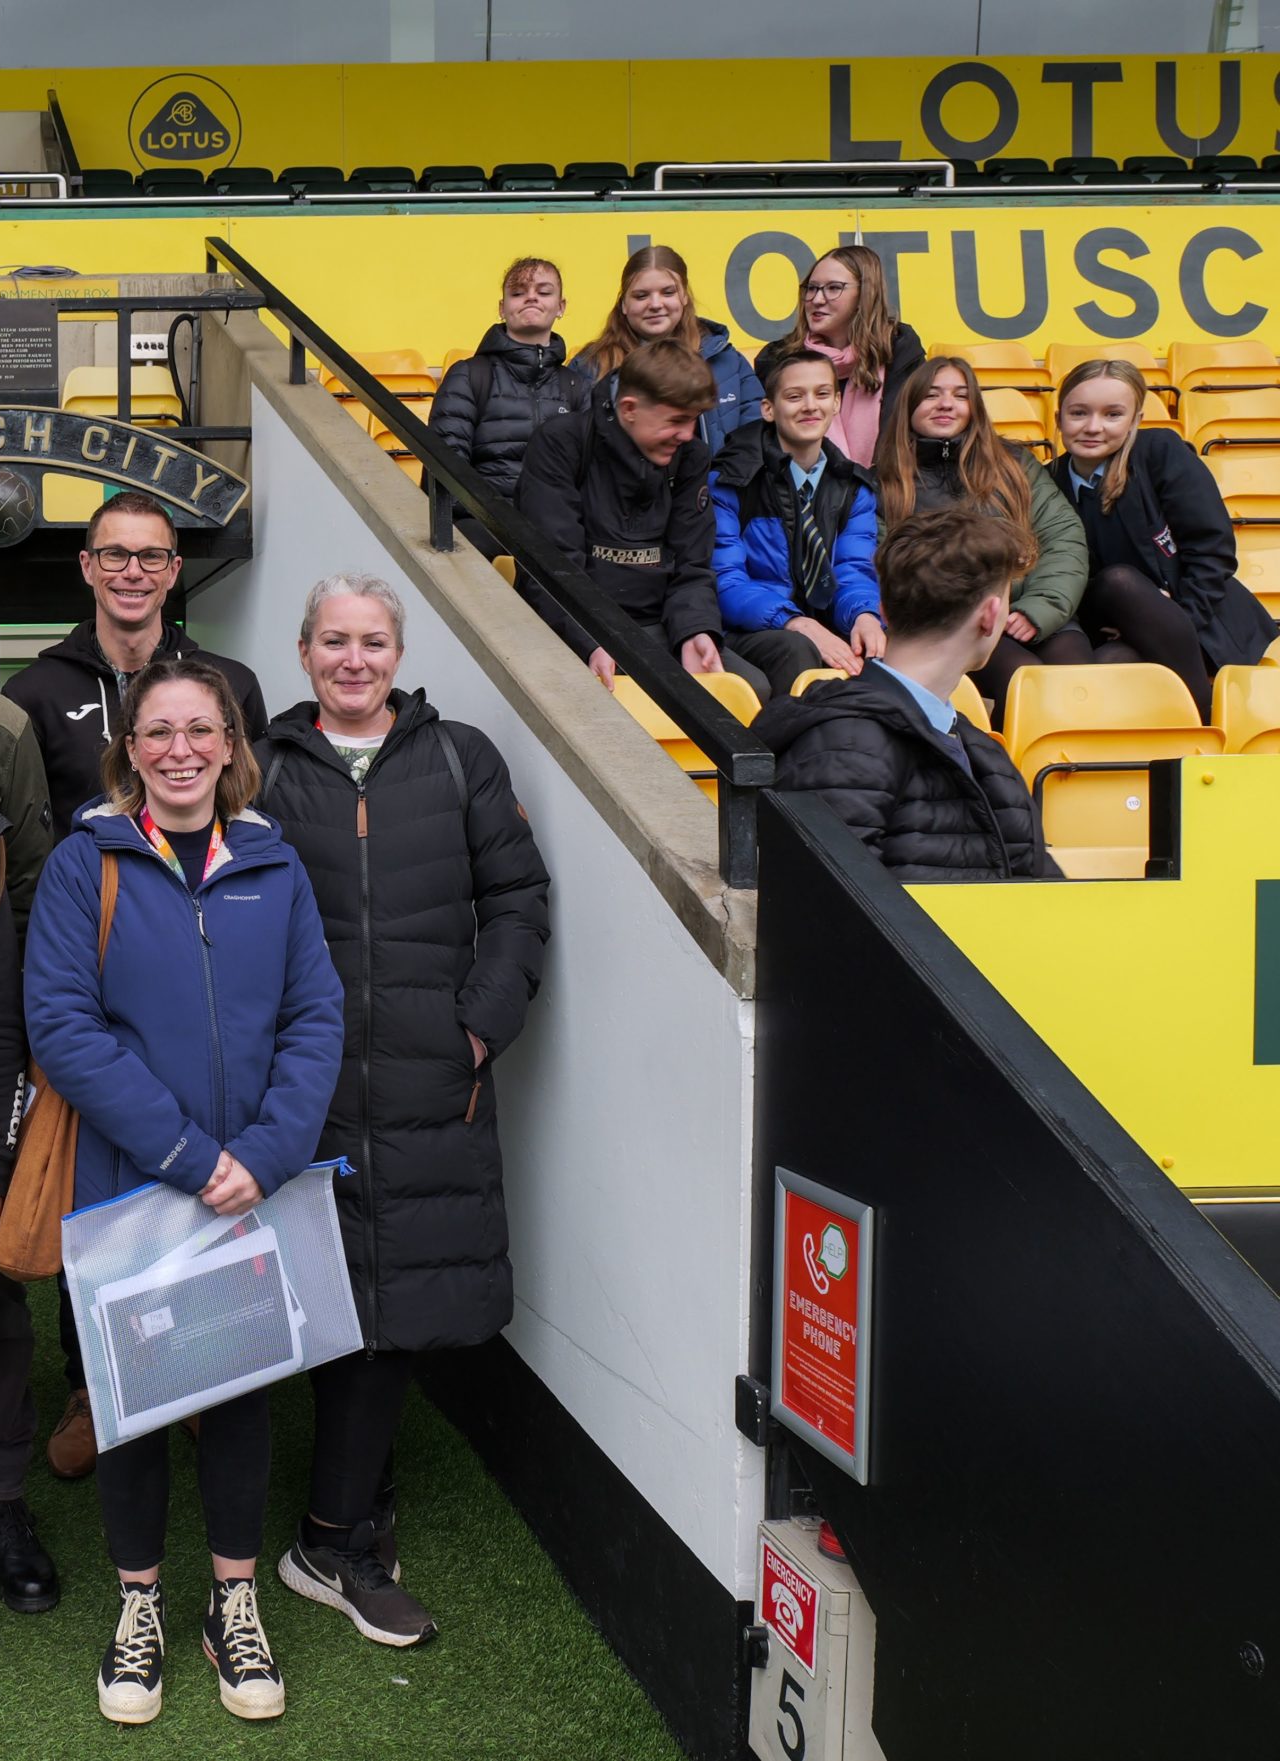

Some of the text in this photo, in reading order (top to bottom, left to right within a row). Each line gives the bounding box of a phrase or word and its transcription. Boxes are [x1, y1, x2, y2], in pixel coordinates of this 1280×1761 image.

[830, 60, 1280, 162] LOTU
[147, 131, 225, 149] LOTUS
[83, 288, 111, 298] BOX
[627, 226, 1269, 342] OTUSC
[81, 426, 220, 502] CITY
[789, 1289, 857, 1346] EMERGENCY
[802, 1321, 841, 1361] PHONE
[766, 1555, 812, 1607] EMERGENCY
[776, 1668, 805, 1761] 5
